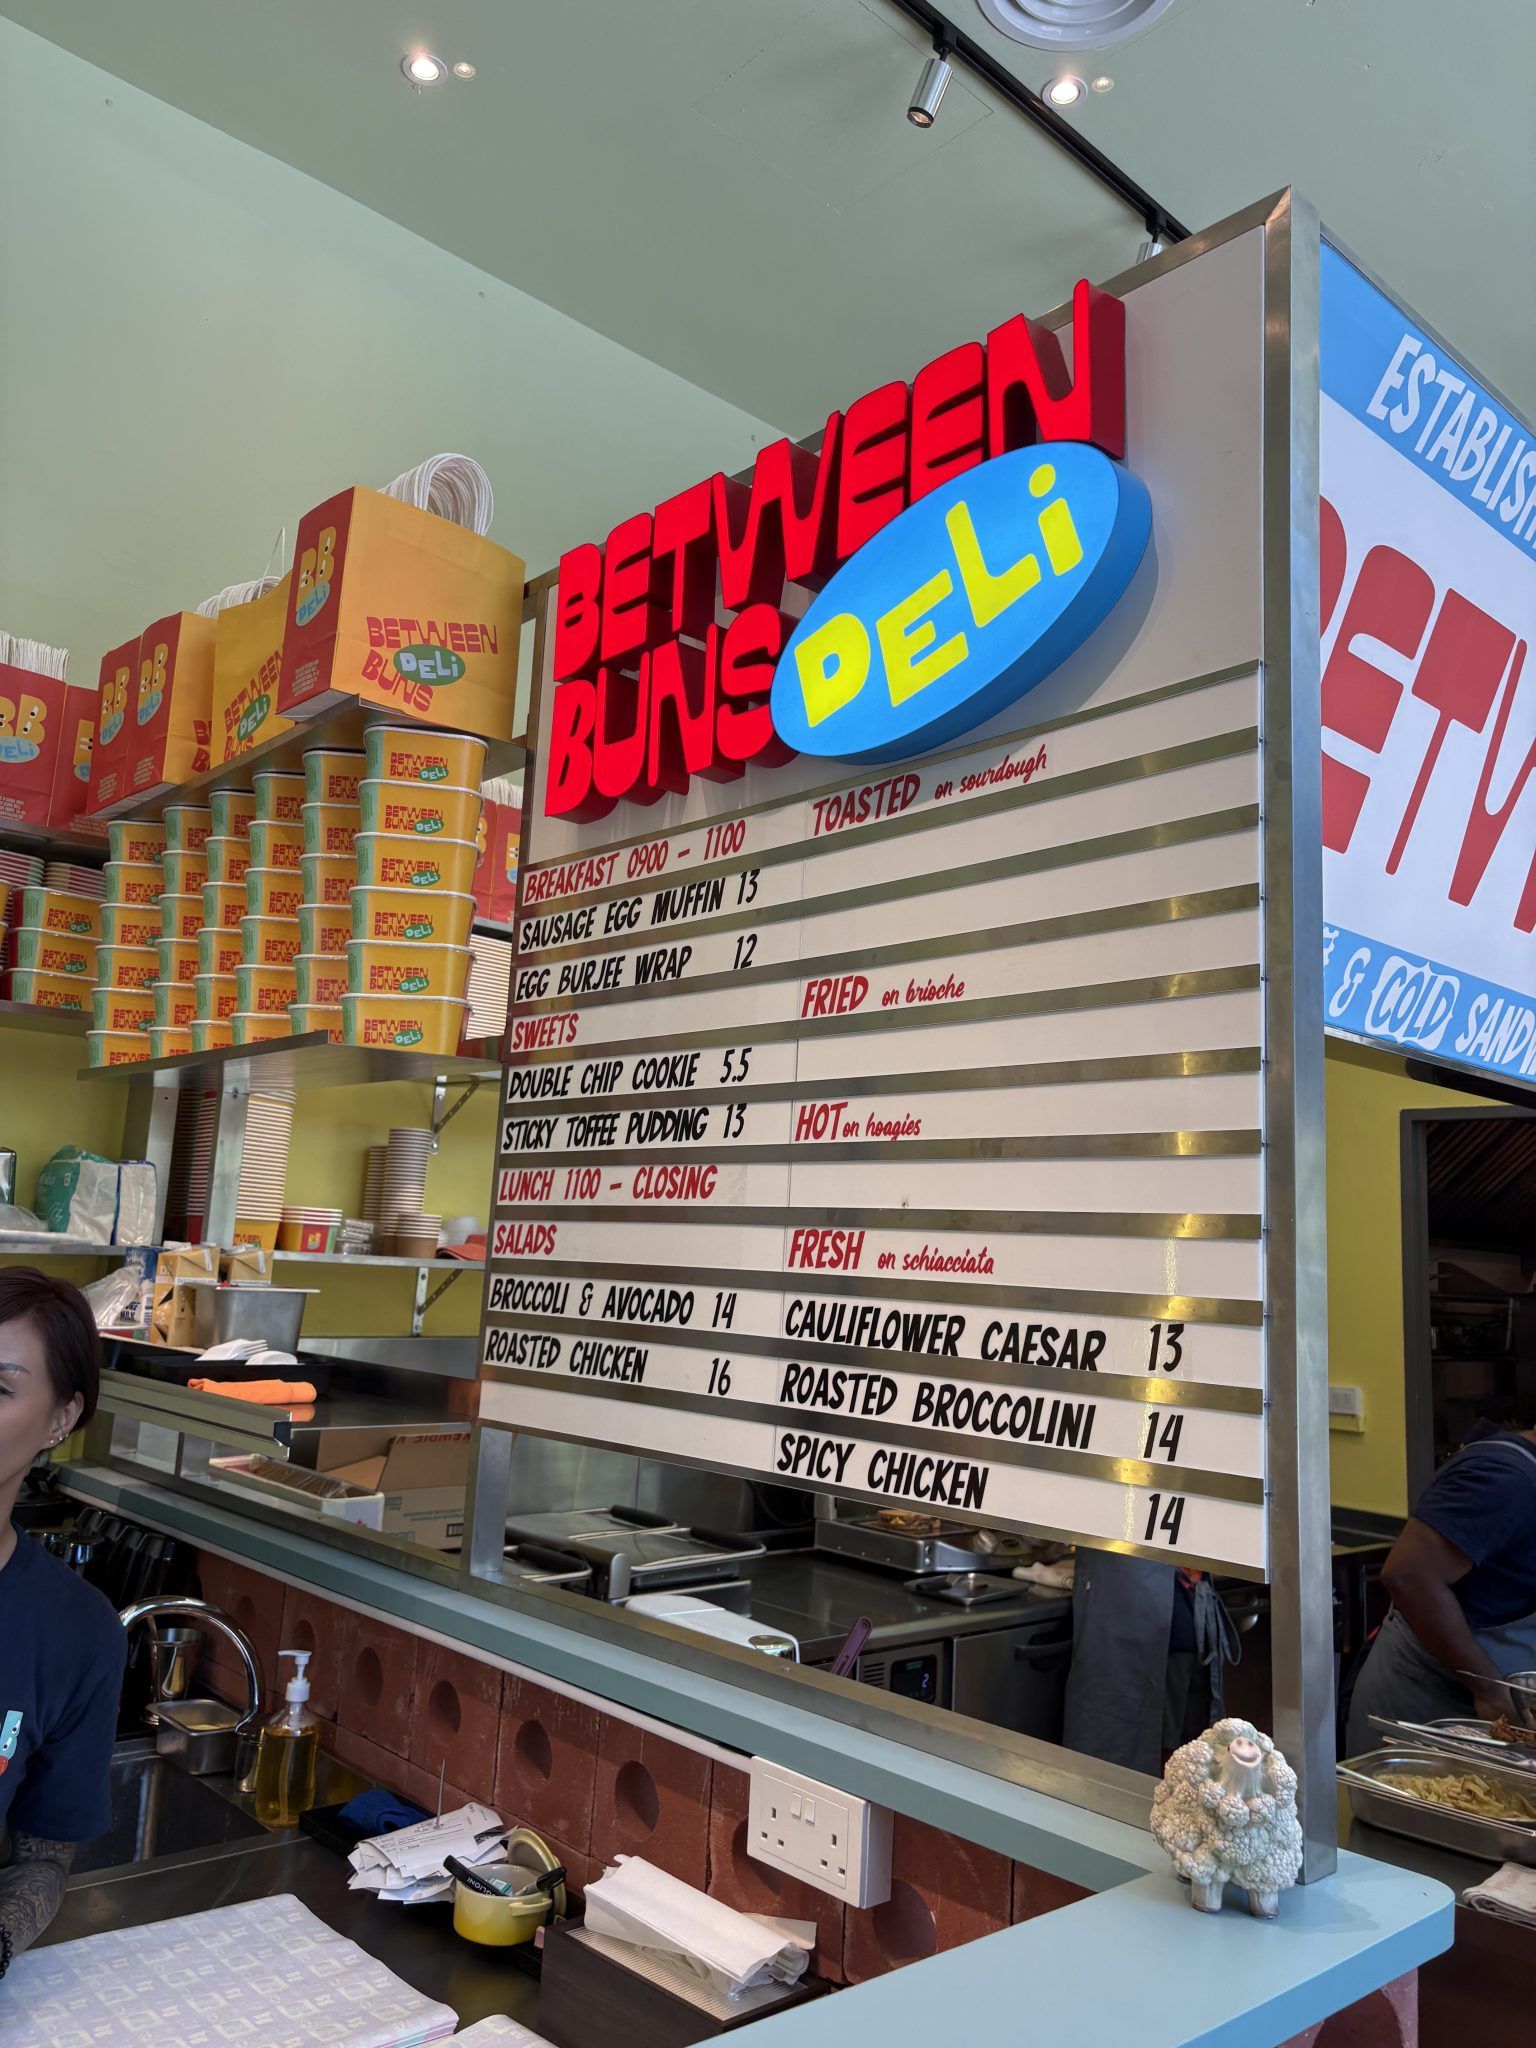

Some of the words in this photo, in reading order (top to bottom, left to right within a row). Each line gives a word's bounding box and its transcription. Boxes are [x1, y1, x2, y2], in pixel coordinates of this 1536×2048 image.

[554, 279, 1092, 683] BETWEEN
[366, 616, 498, 655] BETWEEN
[361, 649, 434, 712] BUNS
[545, 603, 782, 817] BUNS
[1, 740, 36, 759] ELi
[391, 752, 448, 768] BETWEEN
[390, 765, 420, 778] BUNS
[329, 775, 359, 787] BETW
[813, 775, 919, 835] TOASTED
[935, 786, 951, 799] on
[960, 747, 1046, 793] sourdough
[276, 796, 306, 808] BETW
[386, 805, 443, 820] BETWEEN
[385, 818, 414, 831] BUNS
[327, 828, 360, 839] BETW
[129, 841, 166, 851] BETWEE
[272, 844, 306, 855] BETW
[382, 858, 440, 872] BETWEEN
[524, 853, 619, 903] BREAKFAST
[627, 841, 668, 878] 0900
[704, 820, 745, 859] 1100
[324, 878, 358, 890] BETW
[381, 870, 411, 883] BUNS
[126, 883, 165, 893] BETWEE
[270, 892, 304, 903] BETW
[521, 907, 597, 950] SAUSAGE
[604, 898, 642, 934] EGG
[651, 878, 725, 924] MUFFIN
[738, 869, 760, 904] 13
[375, 912, 433, 925] BETWEEN
[122, 925, 162, 934] BETWEE
[321, 928, 353, 939] BETW
[374, 924, 404, 937] BUNS
[119, 966, 159, 976] BETWEE
[370, 965, 428, 978] BETWEEN
[516, 969, 550, 1001] EGG
[558, 956, 625, 994] BURJEE
[635, 946, 692, 985] WRAP
[734, 934, 757, 969] 12
[317, 979, 349, 990] BETW
[370, 978, 399, 990] BUNS
[801, 976, 868, 1018] FRIED
[882, 989, 899, 1006] on
[906, 976, 964, 1003] brioche
[1328, 947, 1371, 1018] &
[1371, 964, 1456, 1040] COLD
[114, 1009, 155, 1019] BETWEE
[365, 1019, 423, 1031] BETWEEN
[512, 1013, 579, 1050] SWEETS
[364, 1031, 394, 1043] BUNS
[509, 1065, 573, 1099] DOUBLE
[581, 1061, 623, 1094] CHIP
[633, 1053, 700, 1090] COOKIE
[720, 1048, 751, 1083] 5.5
[503, 1118, 558, 1150] STICKY
[567, 1113, 620, 1147] TOFFEE
[625, 1108, 709, 1144] PUDDING
[724, 1103, 747, 1138] 13
[795, 1102, 850, 1141] HOT
[843, 1122, 859, 1137] on
[866, 1113, 921, 1141] hoagies
[499, 1169, 555, 1200] LUNCH
[565, 1168, 601, 1199] 1100
[633, 1165, 718, 1200] CLOSING
[494, 1224, 557, 1255] SALADS
[788, 1229, 865, 1270] FRESH
[878, 1253, 895, 1269] on
[903, 1245, 994, 1274] schiacciata
[490, 1279, 569, 1314] BROCCOLI
[579, 1283, 593, 1315] &
[602, 1286, 694, 1325] AVOCADO
[713, 1293, 736, 1328] 14
[785, 1300, 962, 1362] CAULIFLOWER
[982, 1322, 1106, 1371] CAESAR
[1149, 1324, 1184, 1371] 13
[486, 1330, 560, 1367] ROASTED
[570, 1341, 648, 1382] CHICKEN
[708, 1359, 730, 1395] 16
[780, 1361, 897, 1418] ROASTED
[913, 1383, 1095, 1448] BROCCOLINI
[1144, 1413, 1183, 1461] 14
[773, 1431, 853, 1484] SPICY
[865, 1450, 988, 1512] CHICKEN
[1145, 1494, 1184, 1544] 14
